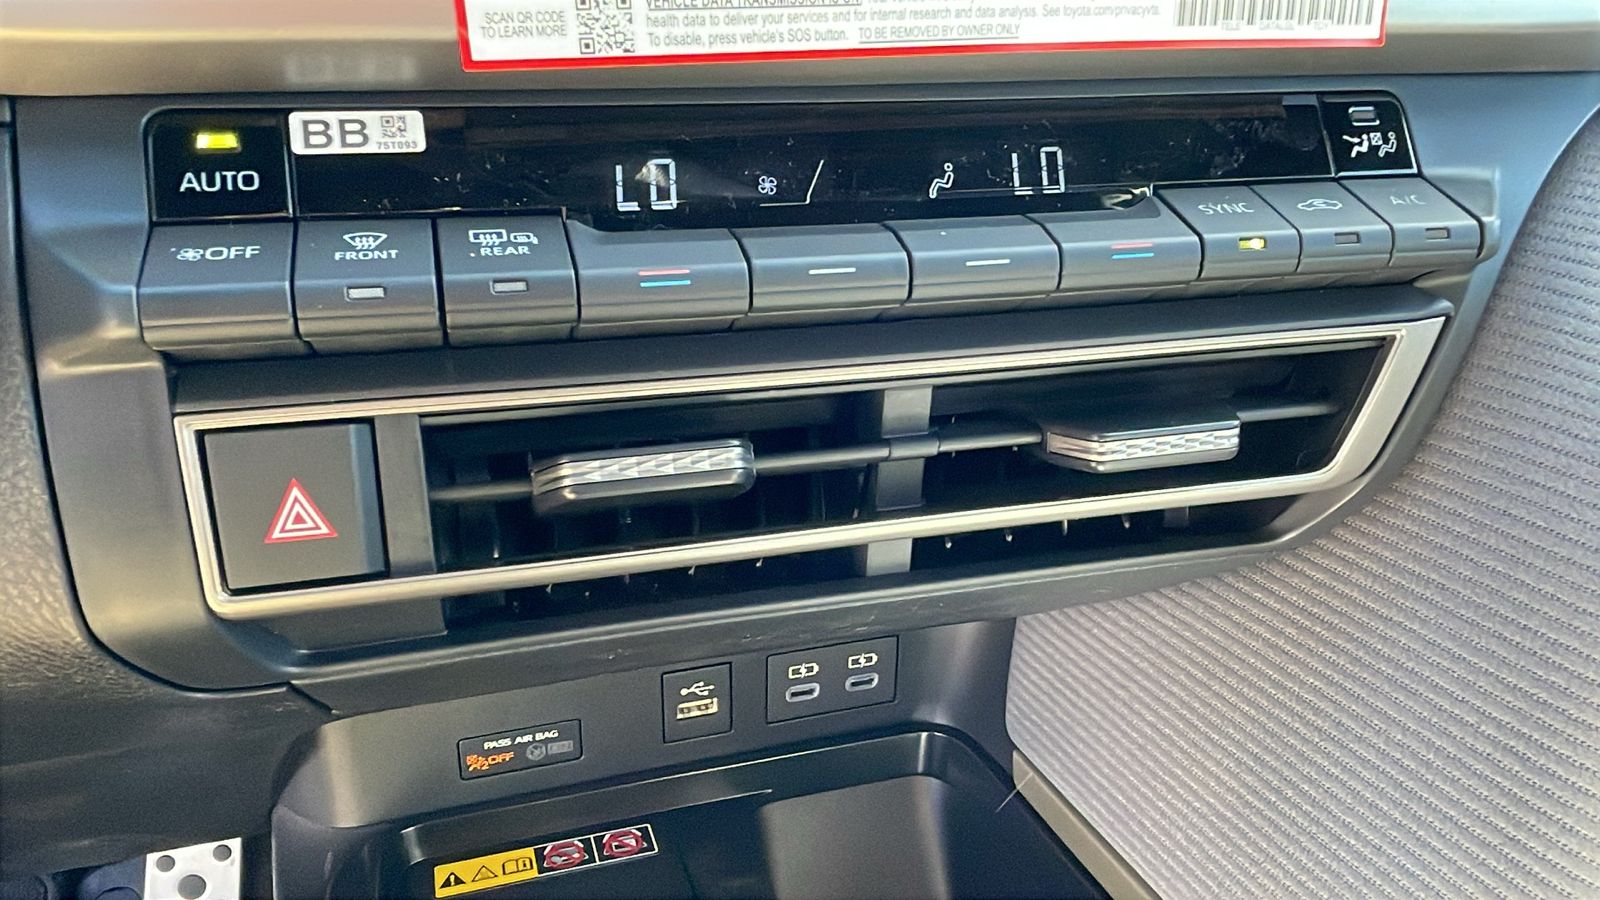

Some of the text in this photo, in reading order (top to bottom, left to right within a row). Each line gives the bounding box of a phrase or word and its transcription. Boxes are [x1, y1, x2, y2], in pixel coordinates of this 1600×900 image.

[485, 10, 566, 25] SCAN QR CODE
[646, 12, 680, 28] health
[682, 12, 706, 27] data
[709, 13, 720, 26] to
[723, 11, 758, 27] deliver
[761, 13, 784, 28] your
[787, 10, 829, 25] services
[832, 9, 851, 23] and
[854, 8, 868, 22] for
[870, 7, 907, 21] internal
[909, 6, 951, 21] research
[954, 5, 972, 19] and
[975, 5, 996, 18] data
[998, 4, 1038, 20] analysis.
[1042, 3, 1060, 17] See
[481, 24, 567, 38] TO LEARN MORE
[647, 22, 1020, 48] To disable, press vehicle's SOS button. TO BE REMOVED BY OWNER ONLY
[302, 119, 369, 149] BB
[179, 171, 260, 192] AUTO
[1390, 194, 1426, 206] A/C
[1198, 202, 1254, 215] SYNC
[204, 246, 261, 260] OFF
[334, 250, 399, 261] FRONT
[480, 245, 531, 257] REAR
[484, 730, 559, 750] PASS AIR BAG
[488, 752, 514, 764] OFF
